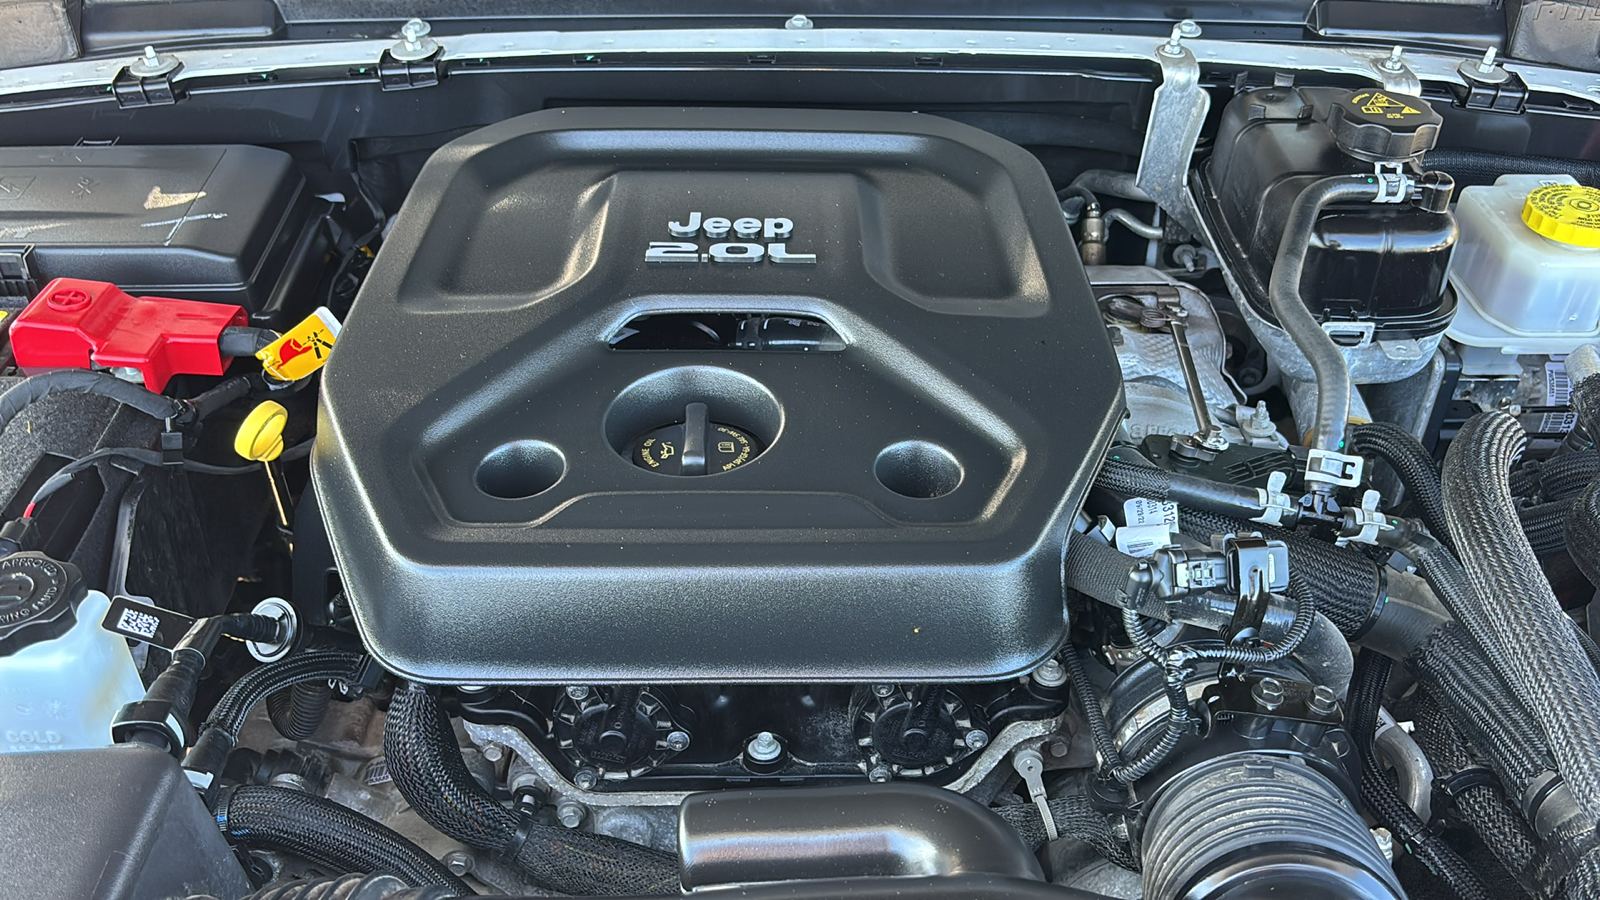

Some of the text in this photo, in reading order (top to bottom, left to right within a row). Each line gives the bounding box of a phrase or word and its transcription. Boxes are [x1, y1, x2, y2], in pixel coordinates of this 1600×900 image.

[668, 212, 794, 242] Jeep
[645, 242, 817, 264] 2.0L
[641, 438, 660, 468] ENGINE OIL
[2, 558, 58, 576] APPROVED
[5, 730, 62, 744] COLD
